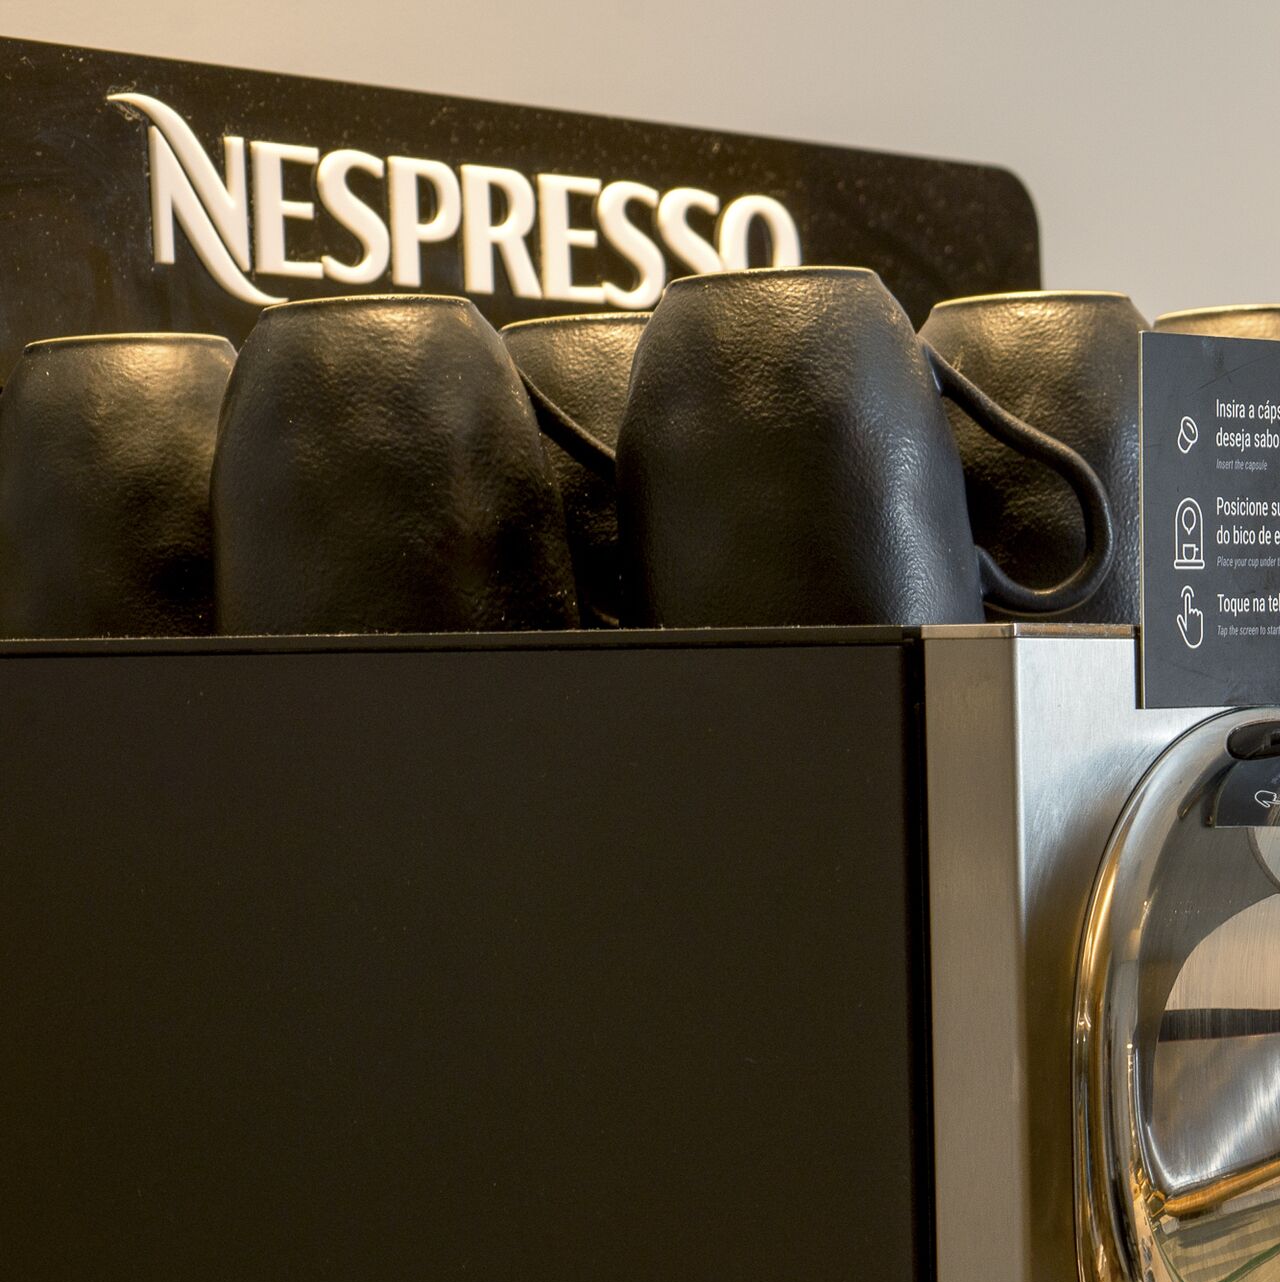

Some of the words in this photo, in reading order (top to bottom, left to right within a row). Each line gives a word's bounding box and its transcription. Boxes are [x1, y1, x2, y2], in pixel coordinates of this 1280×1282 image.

[105, 91, 802, 310] NESPRESSO
[1215, 398, 1246, 419] Insira
[1248, 405, 1255, 420] a
[1215, 426, 1251, 452] deseja
[1216, 458, 1234, 470] Insert
[1234, 458, 1244, 470] the
[1244, 459, 1268, 472] capsule
[1216, 496, 1268, 516] Posicione
[1216, 524, 1231, 545] do
[1233, 524, 1256, 545] bico
[1258, 525, 1272, 545] de
[1216, 555, 1234, 567] Place
[1233, 558, 1247, 570] your
[1247, 558, 1260, 570] cup
[1259, 556, 1276, 568] under
[1217, 593, 1250, 617] Toque
[1252, 598, 1266, 613] na
[1217, 624, 1228, 638] Tap
[1228, 624, 1239, 636] the
[1239, 626, 1260, 636] screen
[1259, 625, 1267, 636] to
[1266, 625, 1280, 636] start
